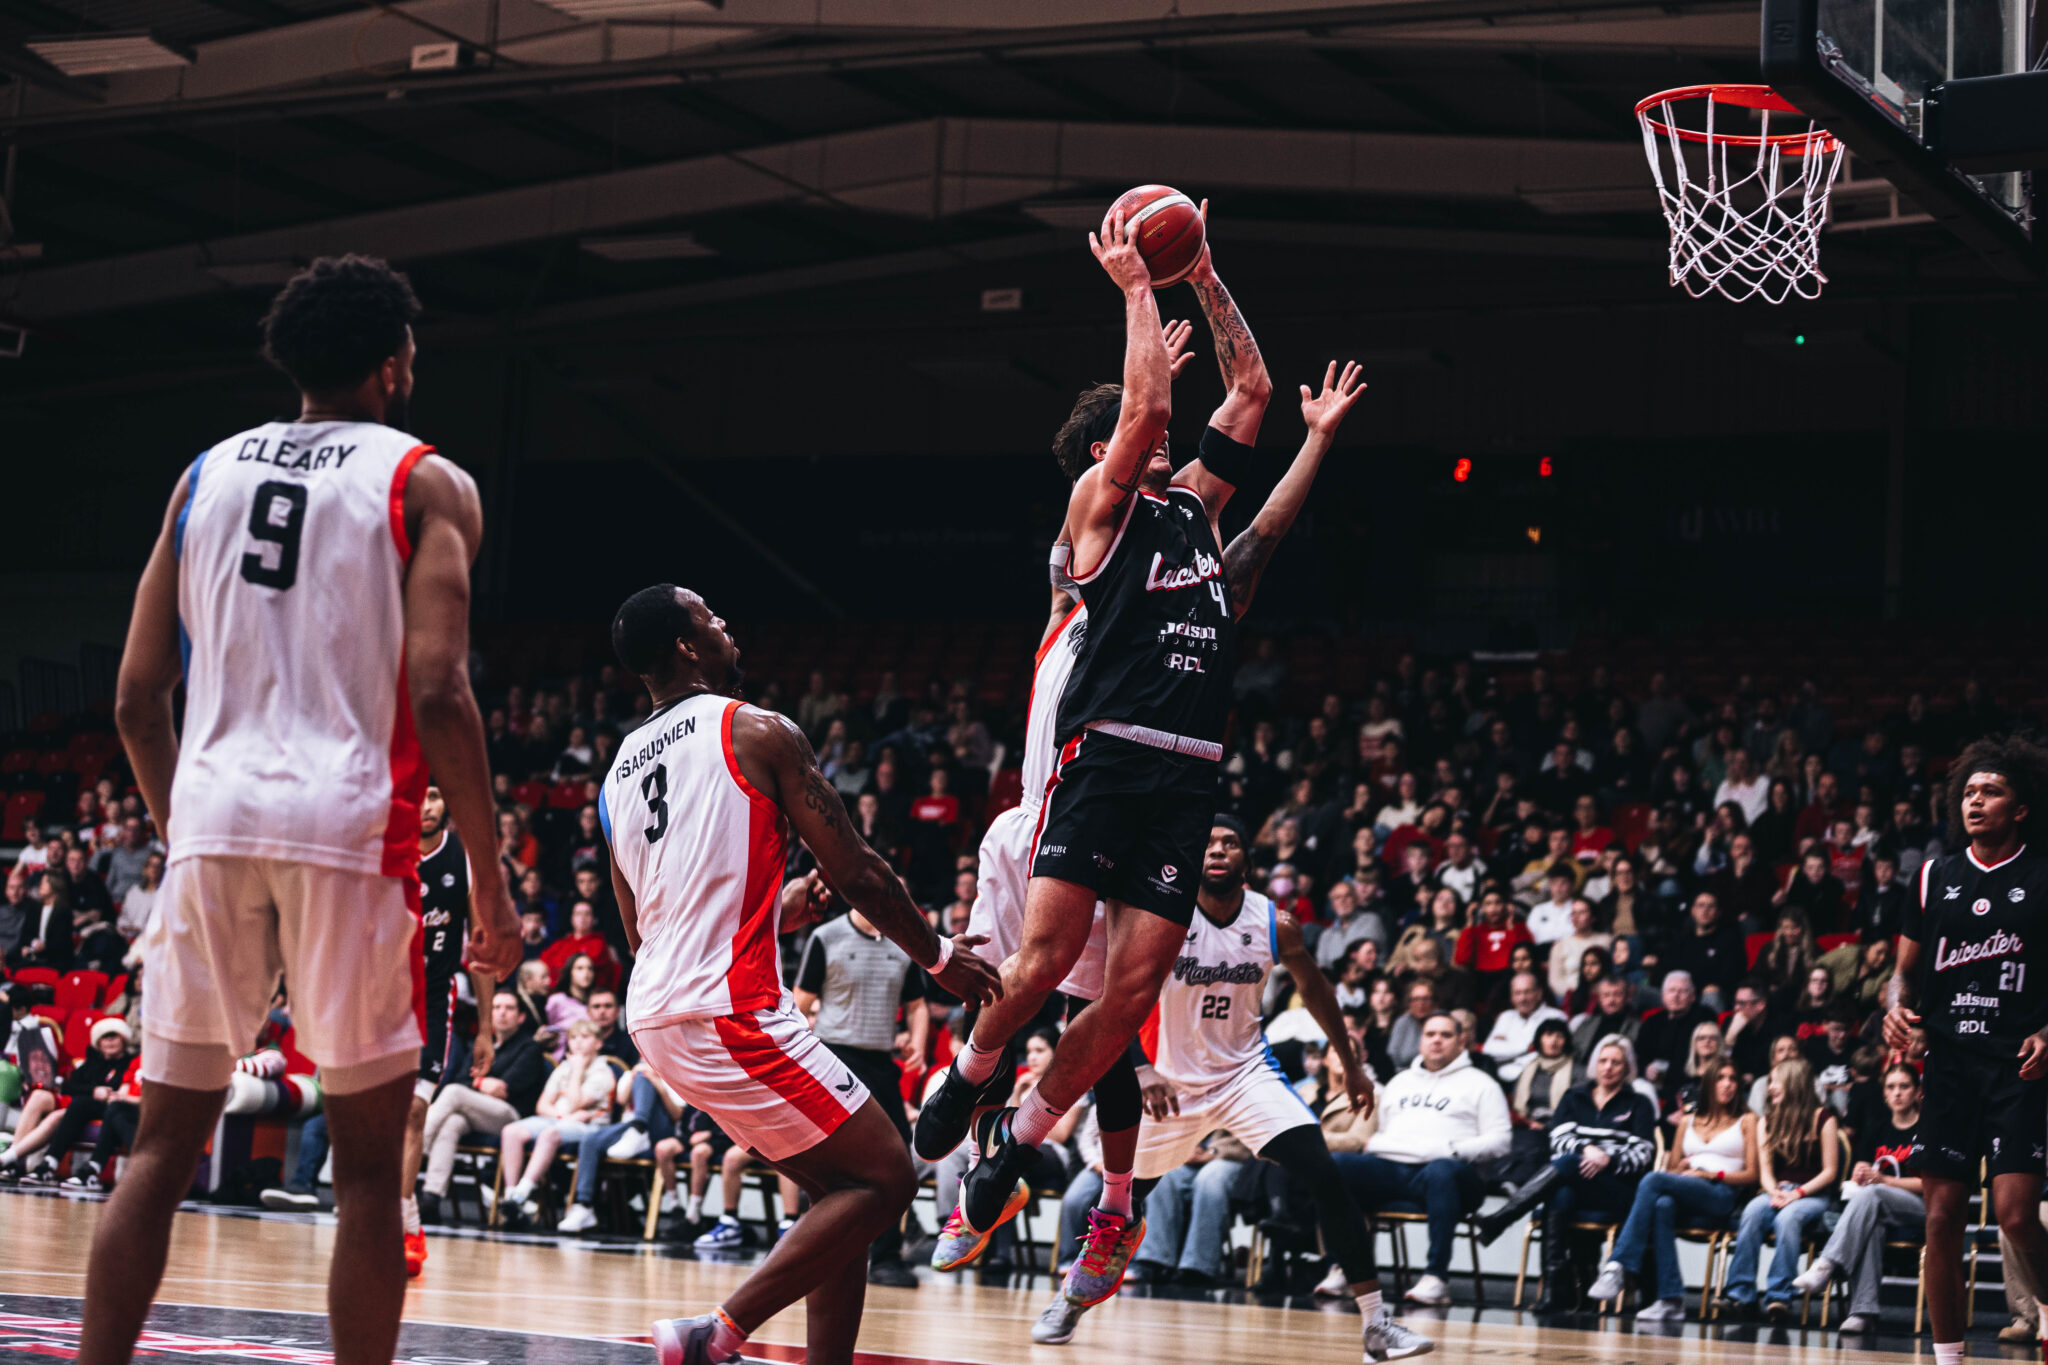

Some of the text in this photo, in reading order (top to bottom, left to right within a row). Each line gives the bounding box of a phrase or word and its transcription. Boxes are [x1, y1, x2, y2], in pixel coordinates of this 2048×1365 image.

[236, 437, 358, 472] CLEARY
[1540, 456, 1552, 477] 6
[1454, 458, 1471, 482] 2
[240, 479, 308, 592] 9
[1208, 580, 1230, 619] 4
[1168, 652, 1206, 673] RDL
[641, 762, 669, 845] 3
[433, 931, 446, 951] 2
[1934, 929, 2024, 973] Leicester
[1173, 956, 1264, 987] Manchester
[1999, 960, 2026, 992] 21
[1201, 995, 1231, 1020] 22
[1951, 993, 2000, 1008] Jelson
[1957, 1020, 1990, 1034] RDL
[1400, 1093, 1451, 1111] POLO
